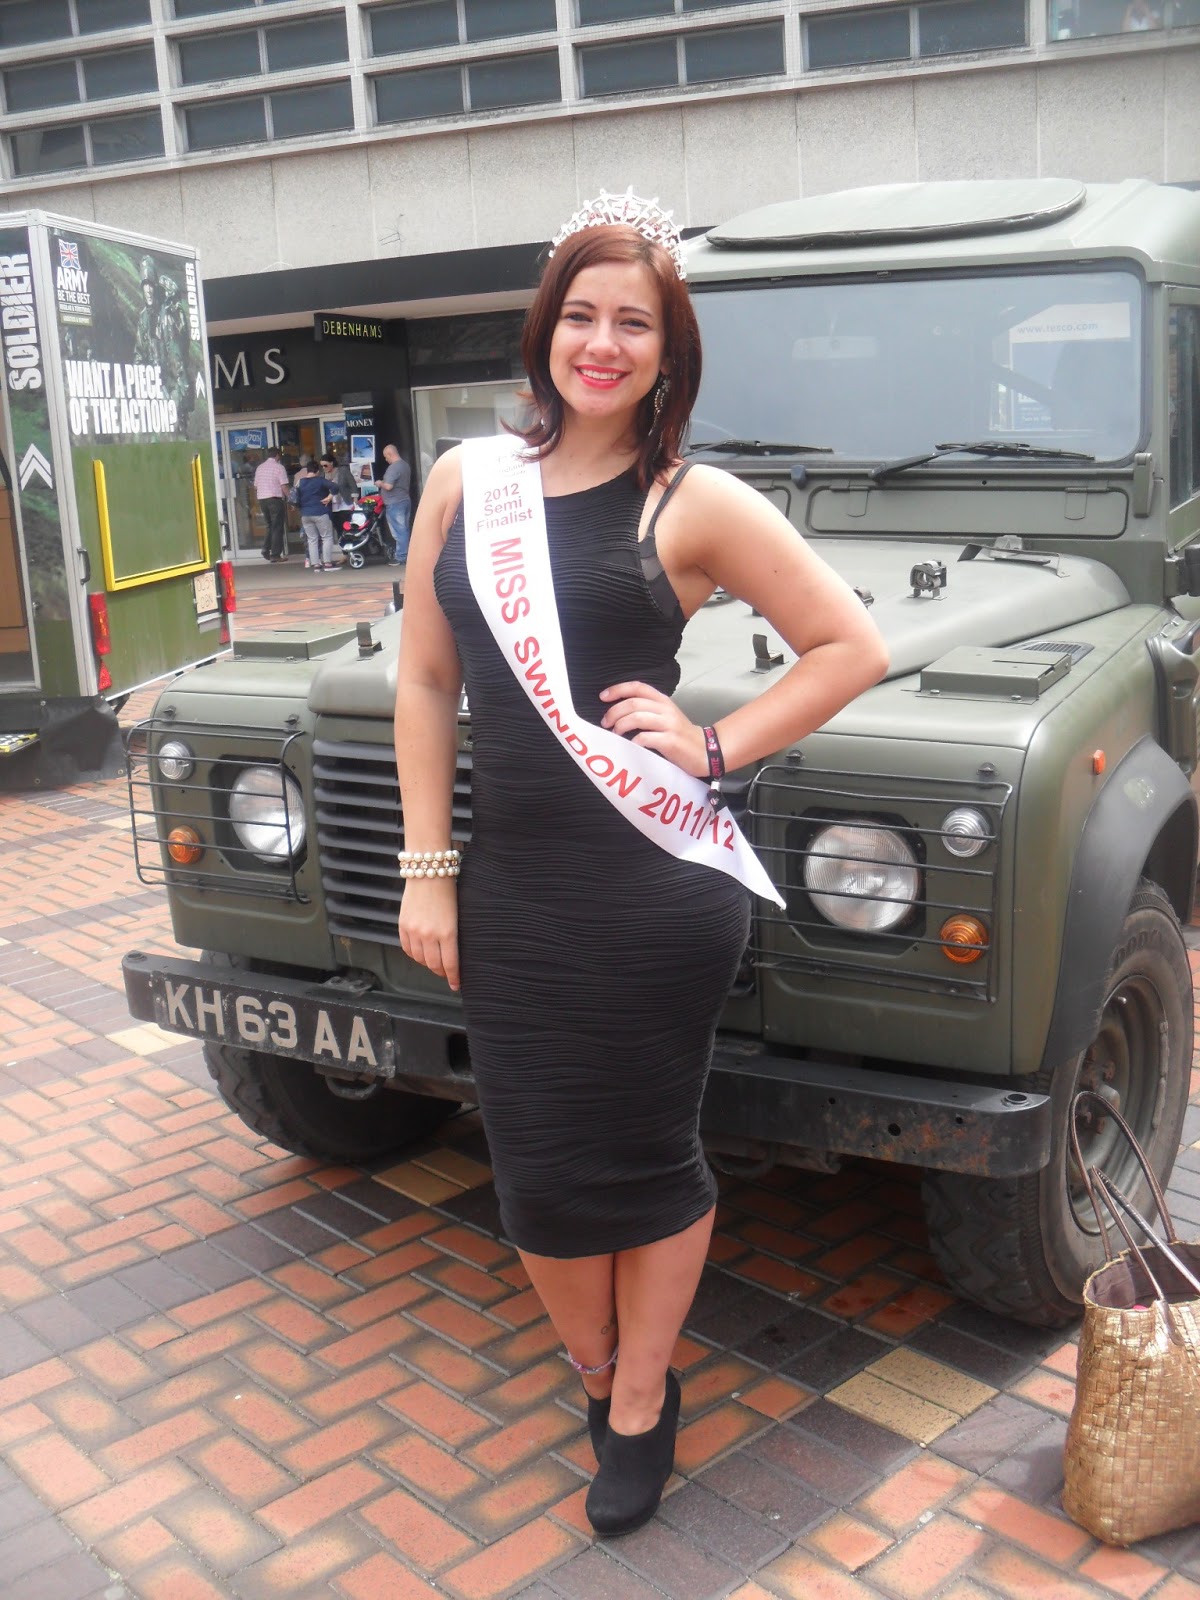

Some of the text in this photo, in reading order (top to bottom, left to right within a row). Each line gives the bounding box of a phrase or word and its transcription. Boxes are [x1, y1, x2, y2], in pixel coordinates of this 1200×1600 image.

[57, 267, 88, 293] ARMY
[58, 290, 90, 304] BE THE BEST
[185, 262, 201, 341] SOLDIER
[0, 254, 42, 391] SOLDIER
[323, 320, 382, 338] DEBENHAMS
[65, 360, 163, 400] WANT A PIECE
[70, 398, 177, 435] OF THE ACTION?
[346, 419, 373, 428] MONEY
[484, 483, 520, 503] 2012
[484, 496, 522, 516] Semi
[477, 508, 533, 533] Finalist
[491, 537, 735, 852] MISS SWINDON 2011/12
[164, 980, 378, 1066] KH 63 AA
